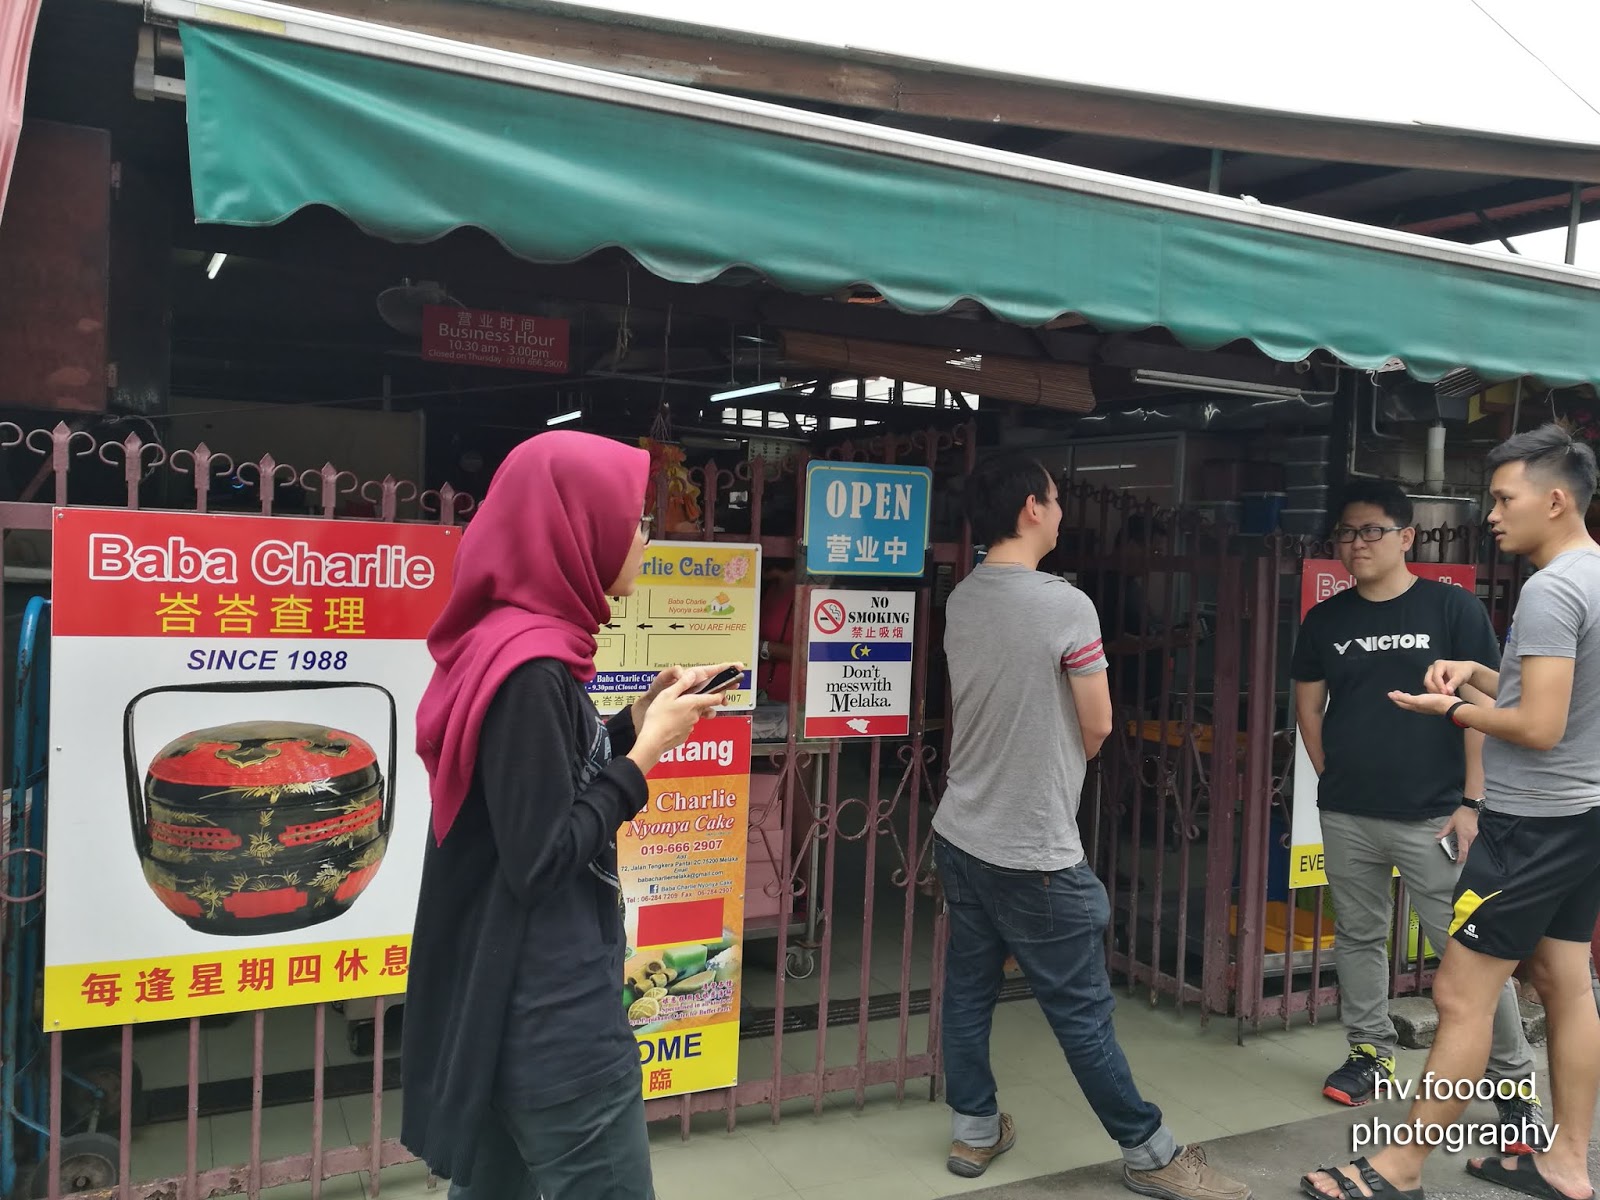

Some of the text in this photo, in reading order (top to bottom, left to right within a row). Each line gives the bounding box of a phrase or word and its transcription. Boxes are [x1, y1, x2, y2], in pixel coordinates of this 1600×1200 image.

[457, 311, 535, 333] 营业时间
[439, 322, 555, 347] Business Hour
[428, 349, 455, 360] Closed
[449, 339, 479, 352] 10.30
[481, 345, 499, 355] am
[508, 345, 549, 359] 3.00pm
[826, 480, 912, 520] OPEN
[826, 534, 908, 565] 营业中
[88, 533, 435, 589] Baba Charlie
[642, 556, 722, 577] rlie Cafe
[668, 597, 707, 606] Baba Charlie
[668, 607, 692, 615] Nyonya
[871, 596, 889, 609] NO
[155, 591, 366, 635] 峇峇查理
[848, 611, 910, 624] SMOKING
[689, 623, 747, 631] YOU ARE HERE
[851, 626, 904, 639] 禁止吸烟
[1355, 634, 1430, 652] VICTOR
[187, 649, 348, 671] SINCE 1988
[615, 673, 640, 683] Charlie
[842, 664, 881, 679] Don't
[726, 695, 742, 703] 907
[829, 692, 892, 713] Melaka.
[659, 739, 734, 767] atang
[656, 788, 737, 812] Charlie
[626, 813, 736, 840] Nyonya Cake
[641, 839, 723, 857] 019-666 2907
[631, 862, 646, 871] Jalan
[648, 860, 674, 871] Tengkera
[1299, 853, 1325, 873] EVE
[676, 883, 697, 891] Charlie
[81, 944, 409, 1007] 每逢星期四休息
